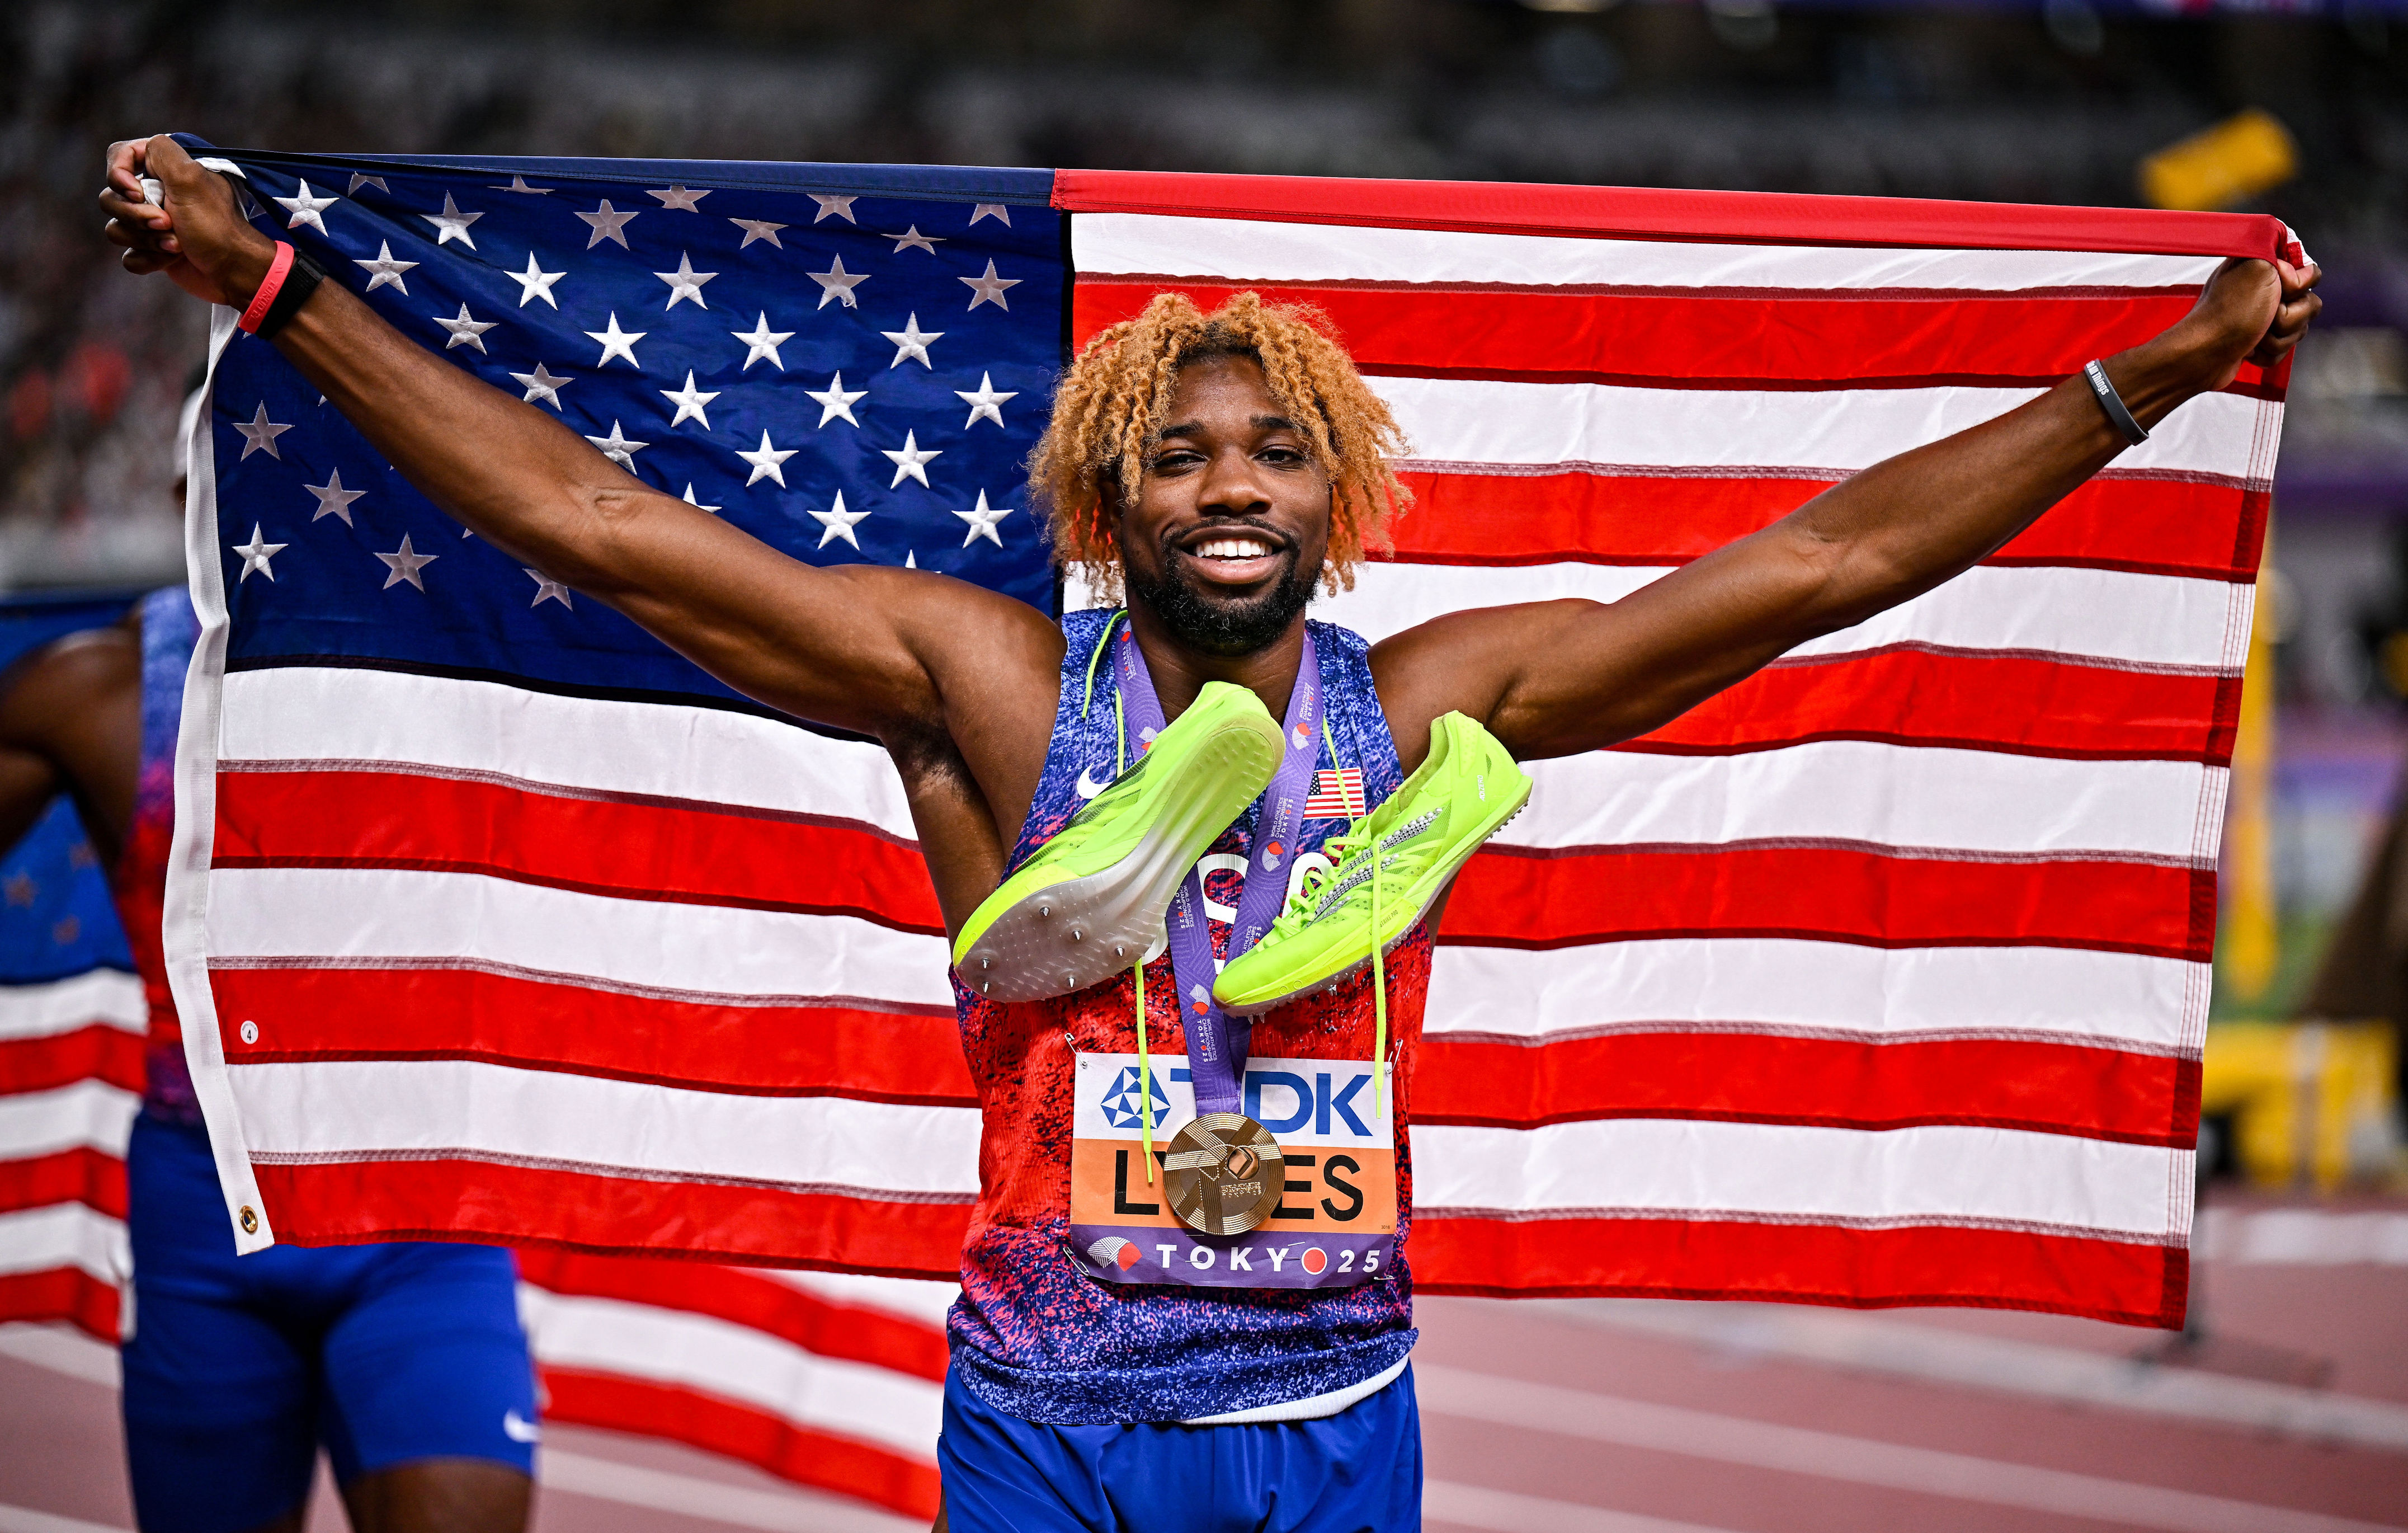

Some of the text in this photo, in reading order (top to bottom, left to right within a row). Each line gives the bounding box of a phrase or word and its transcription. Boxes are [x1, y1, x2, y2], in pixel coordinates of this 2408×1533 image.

[2092, 371, 2109, 396] Things
[1126, 671, 1131, 680] 25
[1477, 775, 1486, 802] ADIZERO
[1275, 797, 1284, 820] ATHLETICS
[1275, 797, 1288, 838] CHAMPIONSHIPS
[1279, 798, 1293, 838] TOKYO 25
[1175, 892, 1185, 929] OKYO 25
[1179, 886, 1190, 928] CHAMPIONSHIPS
[1243, 925, 1252, 950] ATHLETICS
[1255, 927, 1262, 937] 25
[247, 1029, 252, 1041] 4
[1197, 1020, 1208, 1062] TOKYO 25
[1201, 1019, 1213, 1062] CHAMPIONSHIPS
[1209, 1036, 1218, 1061] ATHLETICS
[1114, 1149, 1363, 1221] LES
[1156, 1244, 1381, 1275] TOKYO 25
